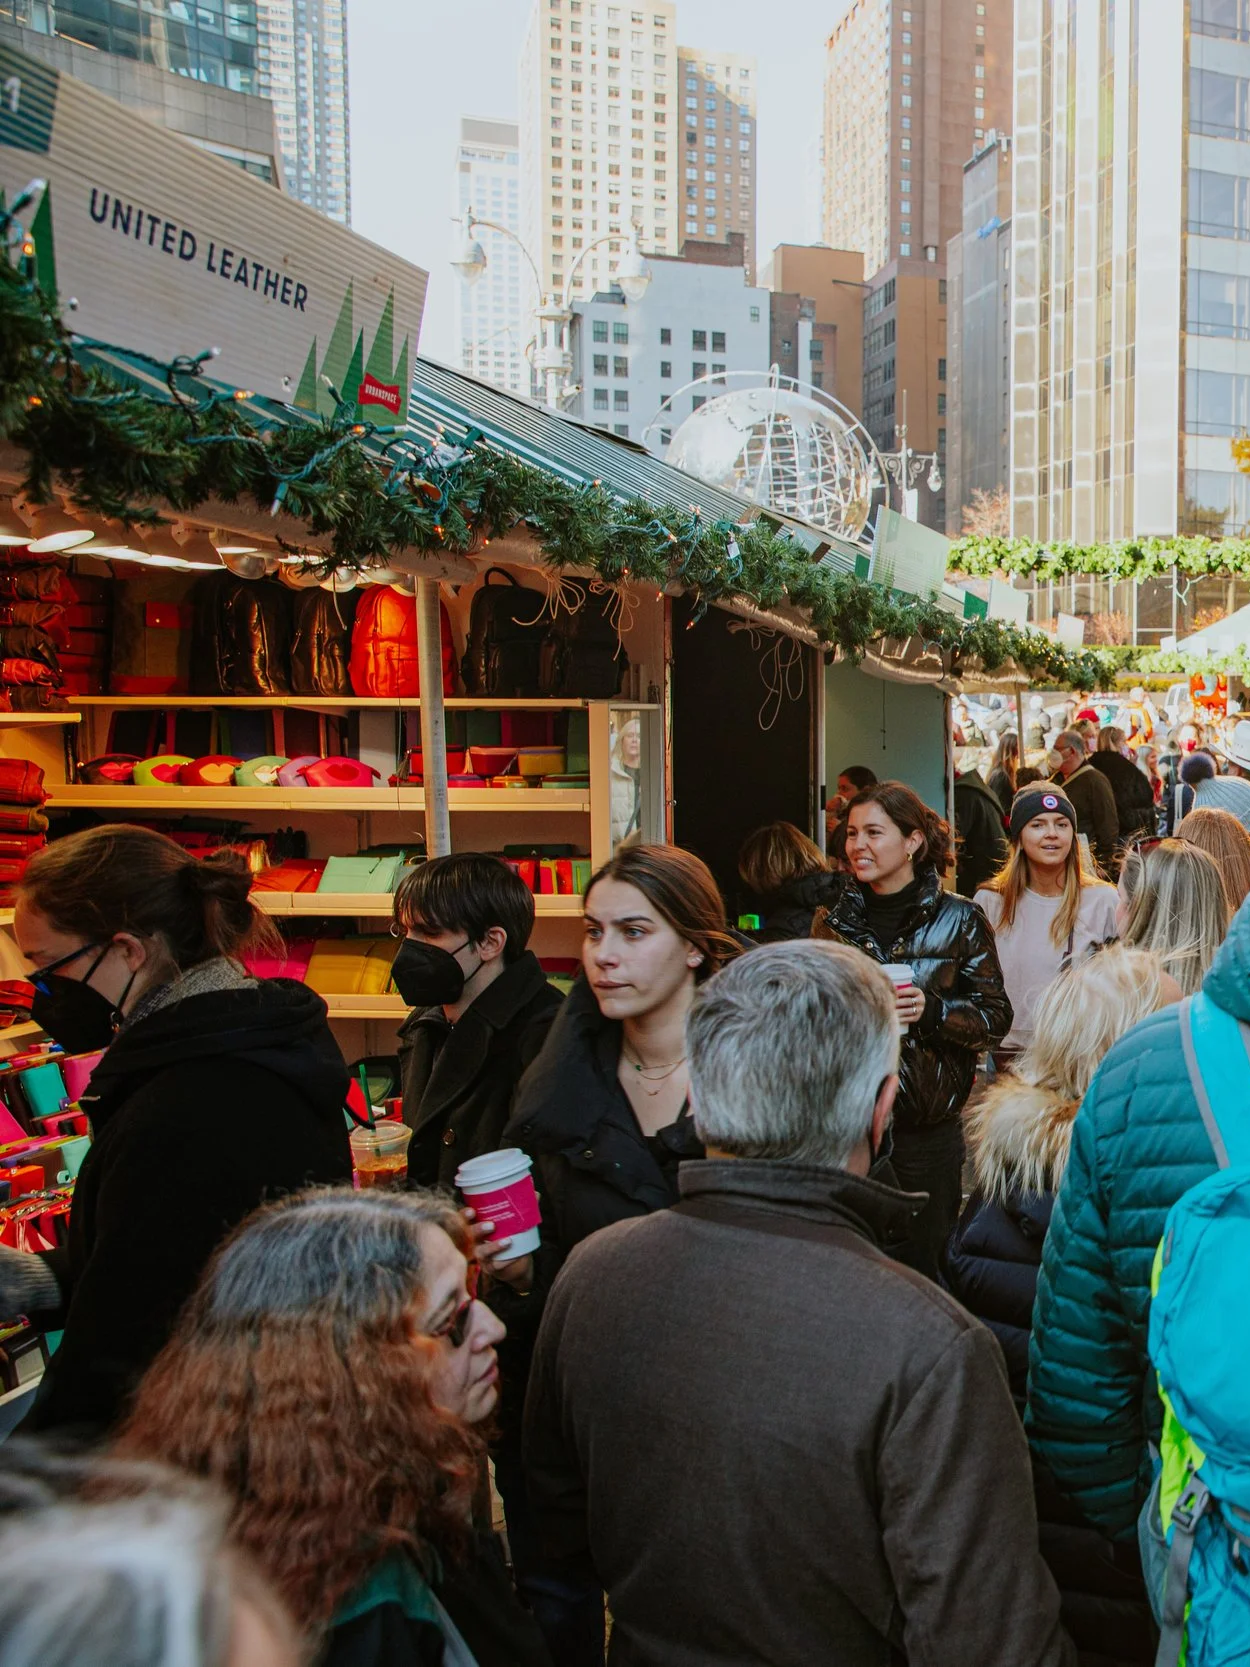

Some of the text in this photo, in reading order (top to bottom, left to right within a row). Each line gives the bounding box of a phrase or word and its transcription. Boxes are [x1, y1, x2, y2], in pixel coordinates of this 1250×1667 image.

[0, 76, 21, 113] 1
[90, 187, 308, 312] UNITED LEATHER
[364, 383, 398, 405] URBANSPACE
